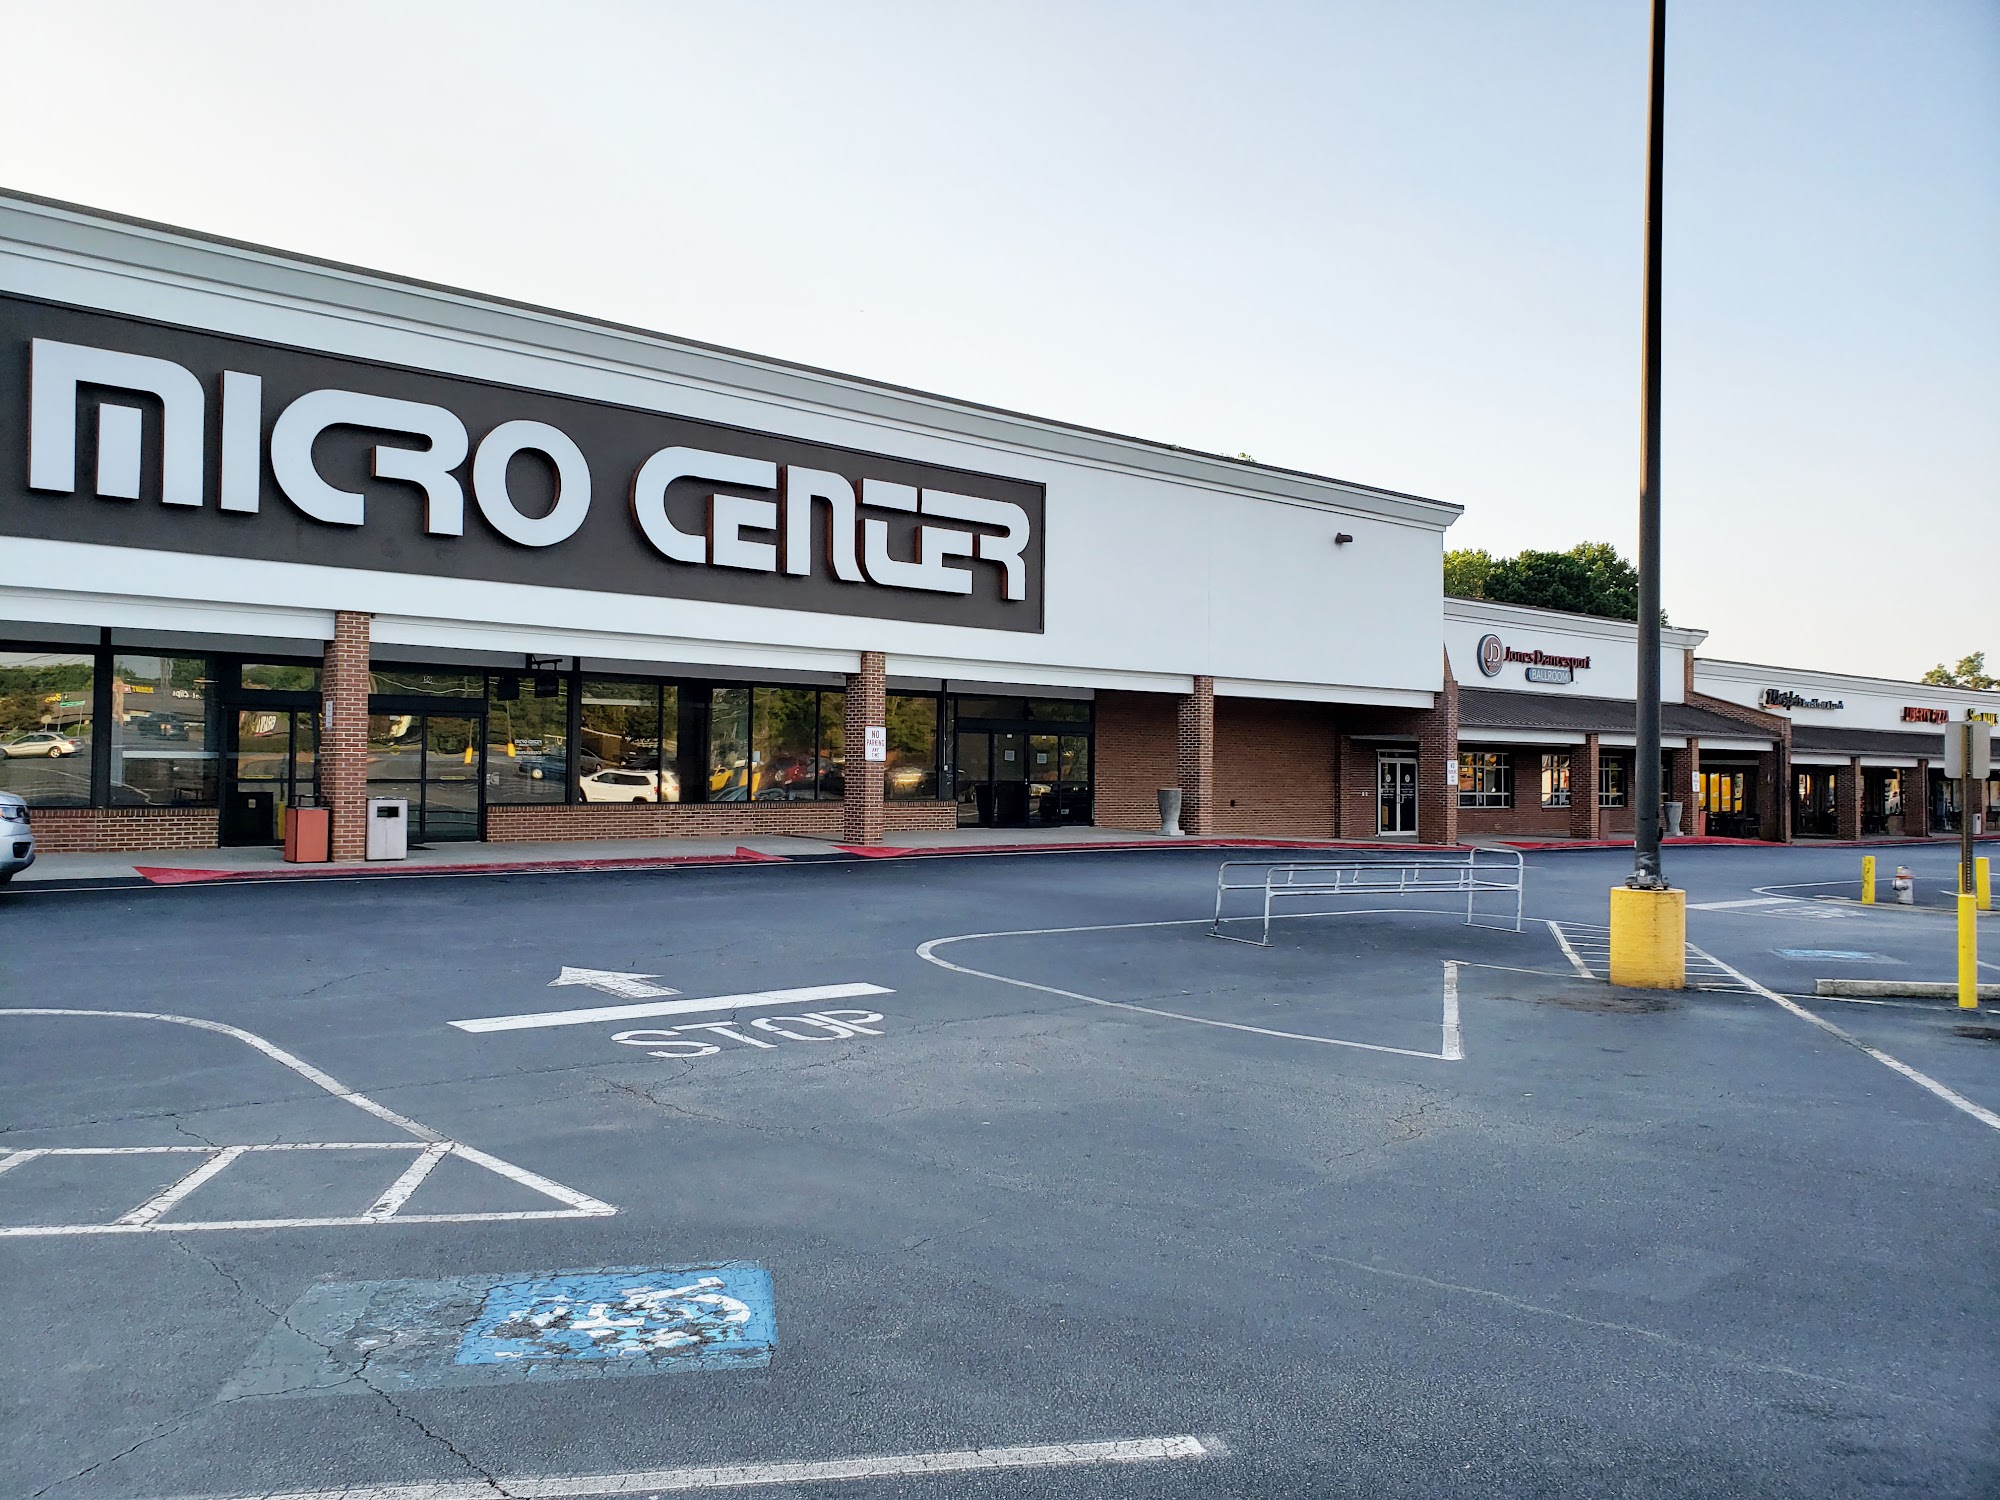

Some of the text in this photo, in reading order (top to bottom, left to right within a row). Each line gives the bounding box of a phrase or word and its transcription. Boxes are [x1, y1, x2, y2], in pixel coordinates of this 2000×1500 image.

[28, 338, 1030, 601] MICRO CENTER
[1532, 669, 1569, 682] BALLROOM
[872, 730, 880, 738] NO
[867, 739, 885, 747] PARKING
[610, 1009, 886, 1059] STOP
